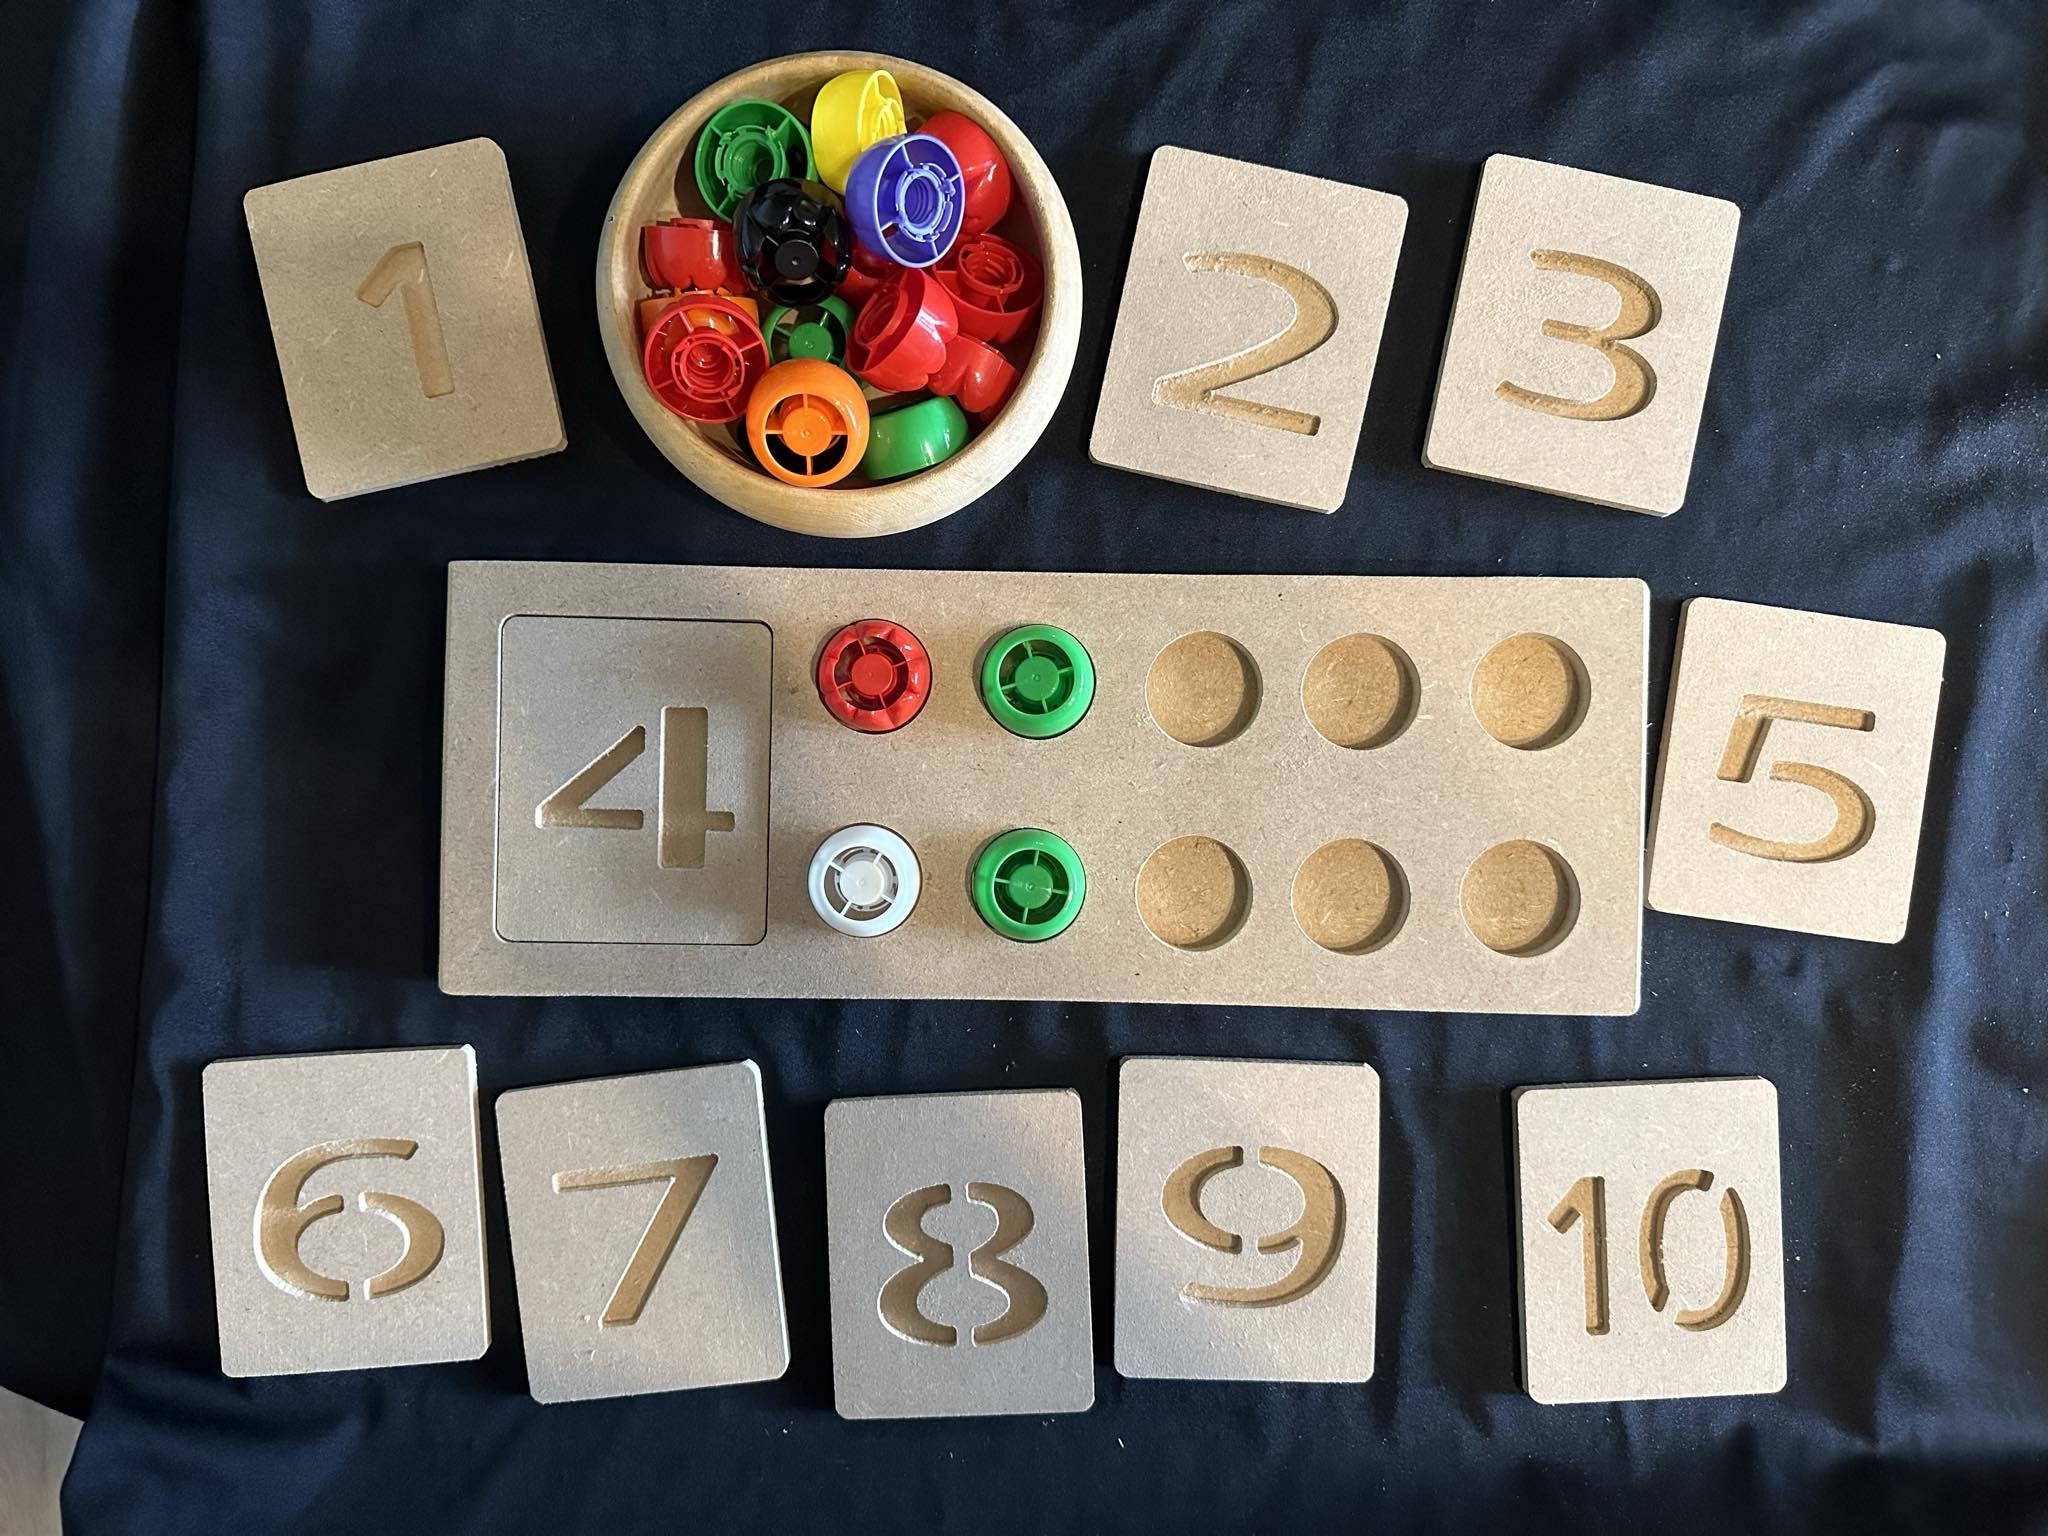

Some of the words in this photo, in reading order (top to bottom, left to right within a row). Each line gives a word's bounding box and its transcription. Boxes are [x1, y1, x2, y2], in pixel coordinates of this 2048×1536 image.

[357, 240, 455, 399] 1
[1150, 251, 1338, 435] 2
[1498, 249, 1660, 422] 3
[536, 704, 736, 869] 4
[1711, 696, 1875, 862] 5
[254, 1136, 446, 1302] 6
[552, 1153, 719, 1329] 7
[876, 1181, 1049, 1348] 8
[1161, 1144, 1343, 1309] 9
[1546, 1168, 1751, 1336] 10
